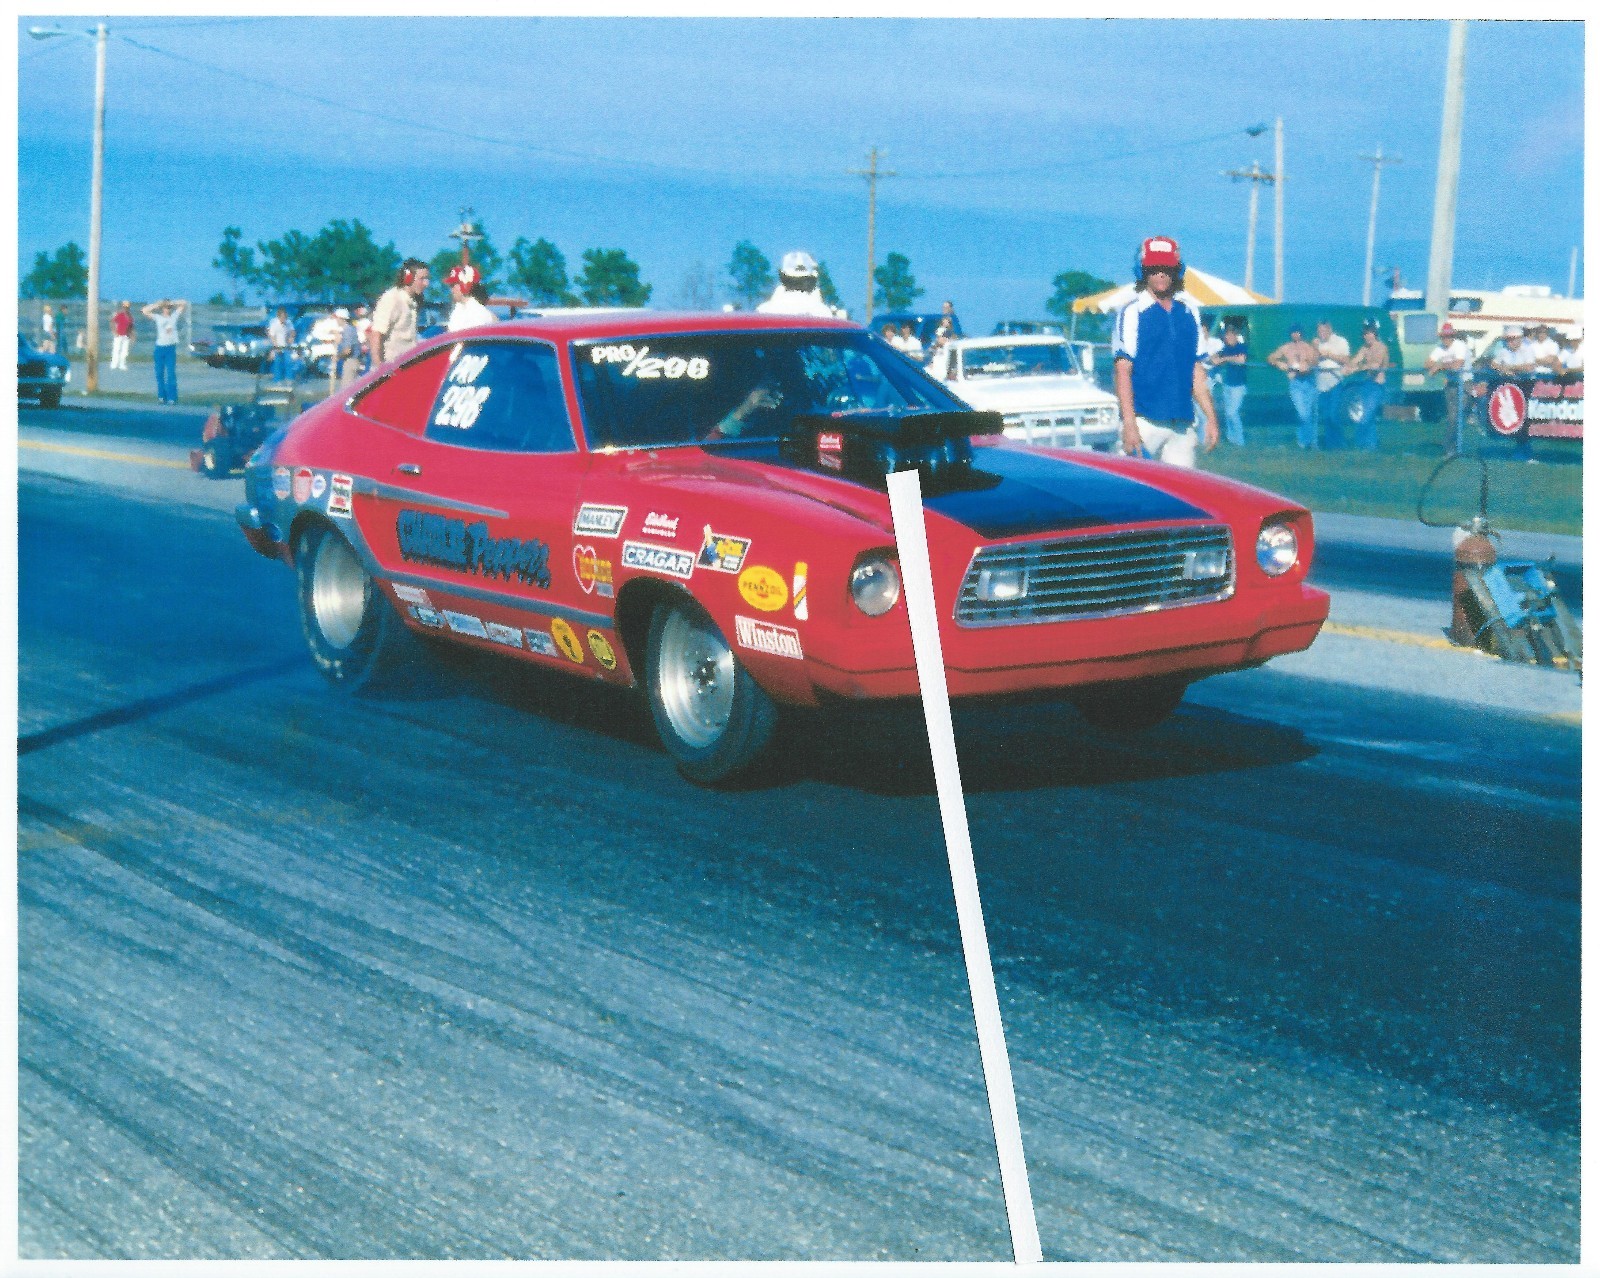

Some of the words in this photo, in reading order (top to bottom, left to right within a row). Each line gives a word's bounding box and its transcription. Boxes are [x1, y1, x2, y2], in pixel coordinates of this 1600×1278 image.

[434, 386, 492, 429] 298
[626, 547, 691, 574] CRAGAR
[742, 580, 783, 597] PENNZOIL
[738, 620, 799, 656] Winston
